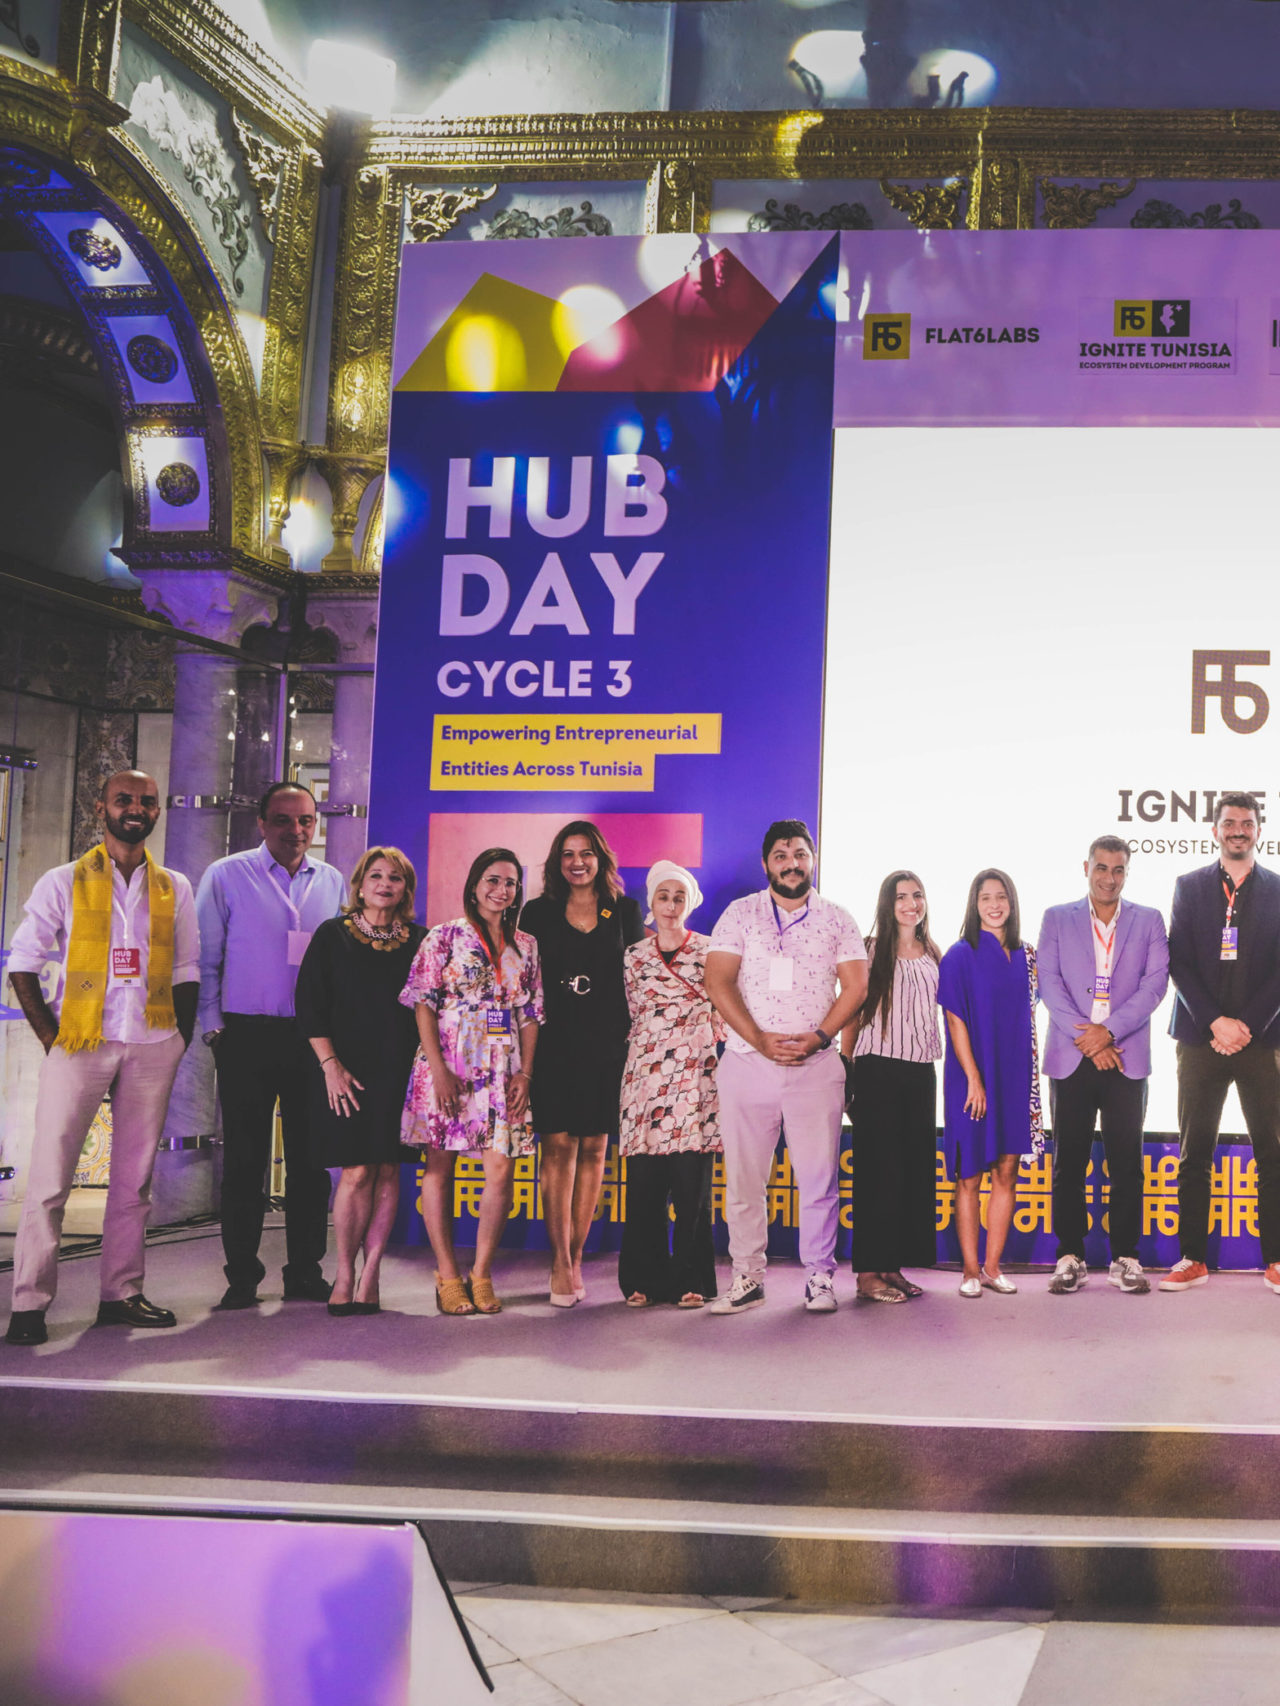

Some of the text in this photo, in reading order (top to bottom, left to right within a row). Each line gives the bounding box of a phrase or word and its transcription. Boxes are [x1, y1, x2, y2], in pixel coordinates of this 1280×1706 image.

[925, 327, 1040, 344] FLAT6LABS
[1079, 343, 1232, 357] IGNITE TUNISIA
[1079, 361, 1231, 369] ECOSYSTEM DEVELOPMENT PROGRAM
[445, 454, 668, 539] HUB
[439, 552, 665, 636] DAY
[437, 660, 632, 698] CYCLE 3
[441, 724, 698, 745] Empowering Entrepreneurial
[441, 761, 643, 776] Entities Across Tunisia
[1117, 789, 1266, 823] IGNI
[1126, 839, 1220, 854] COSYSTEM
